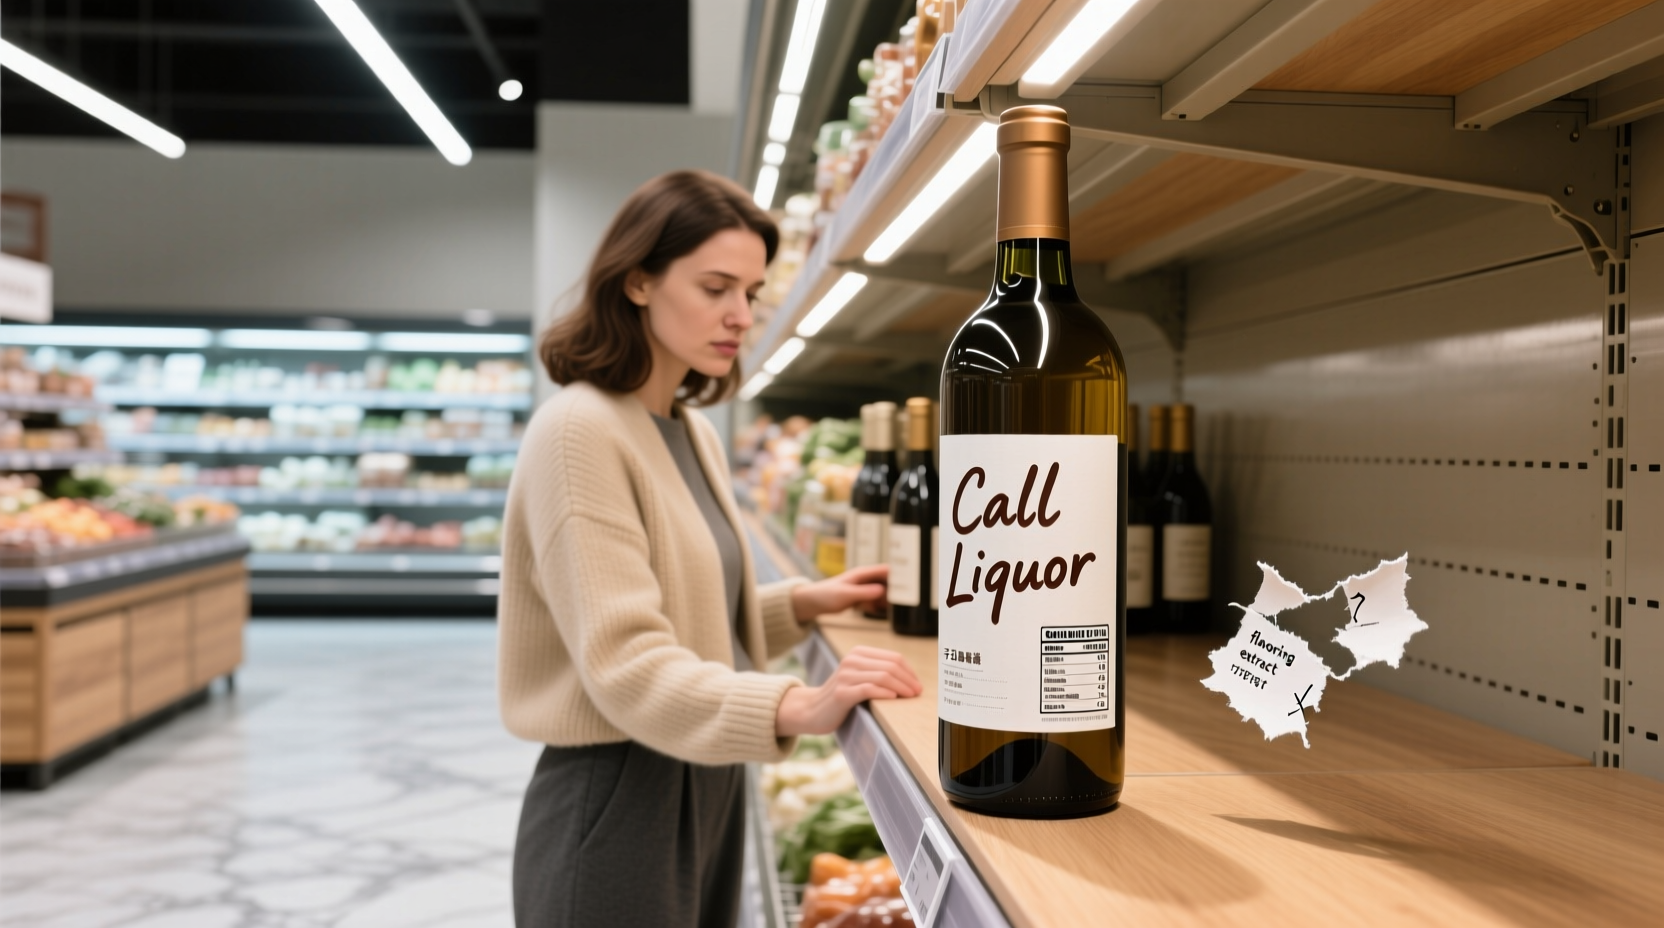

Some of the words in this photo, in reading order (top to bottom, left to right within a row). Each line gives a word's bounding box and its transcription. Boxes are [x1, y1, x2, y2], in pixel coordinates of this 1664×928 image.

[953, 462, 1061, 535] Call
[946, 542, 1096, 625] Liquor
[1240, 649, 1278, 675] extract
